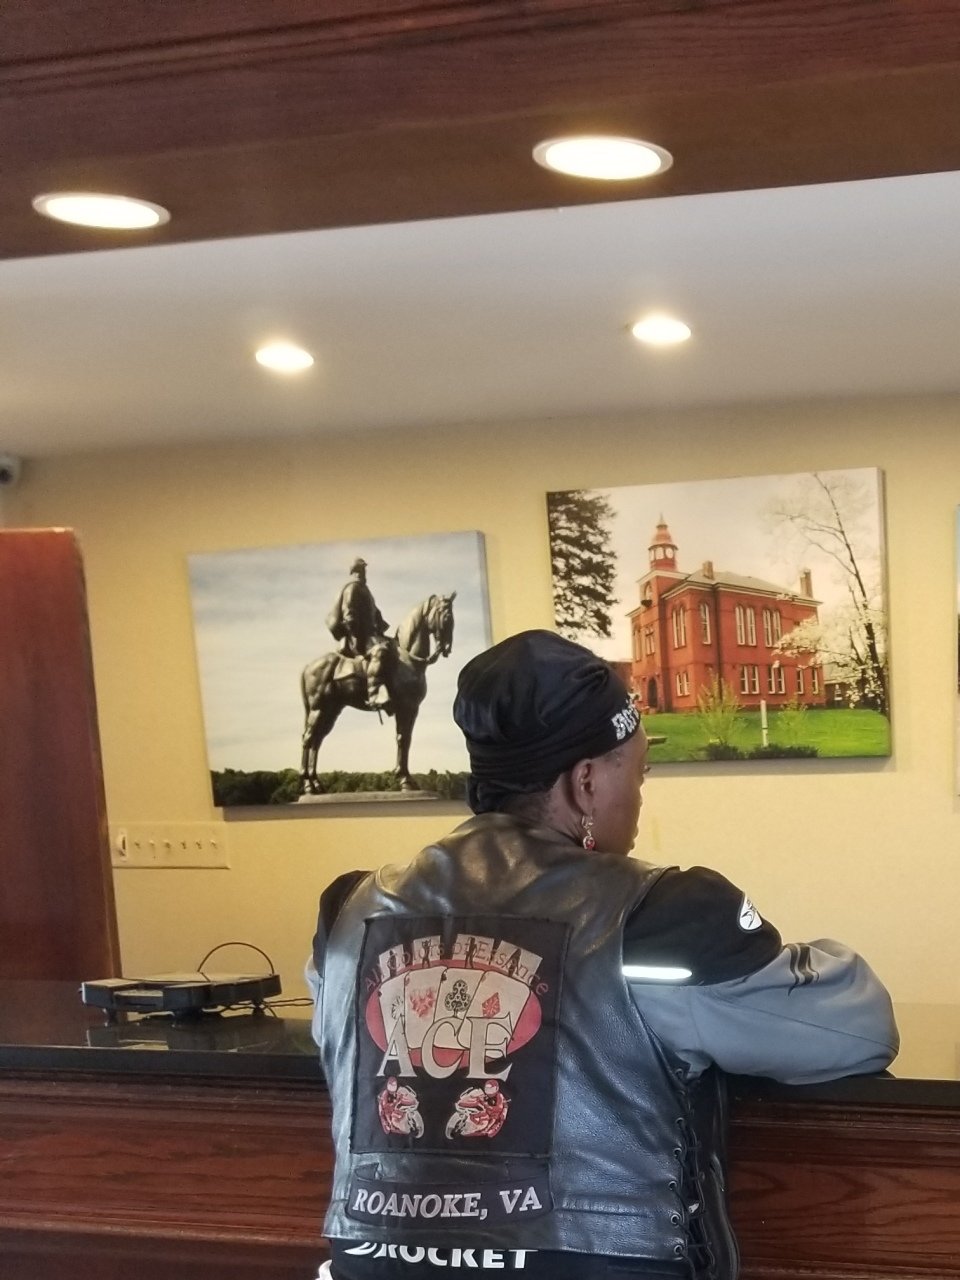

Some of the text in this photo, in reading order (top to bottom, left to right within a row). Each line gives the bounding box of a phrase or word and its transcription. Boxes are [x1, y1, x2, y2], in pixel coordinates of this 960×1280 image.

[376, 1015, 513, 1082] ACE
[353, 1186, 543, 1220] ROANOKE, VA
